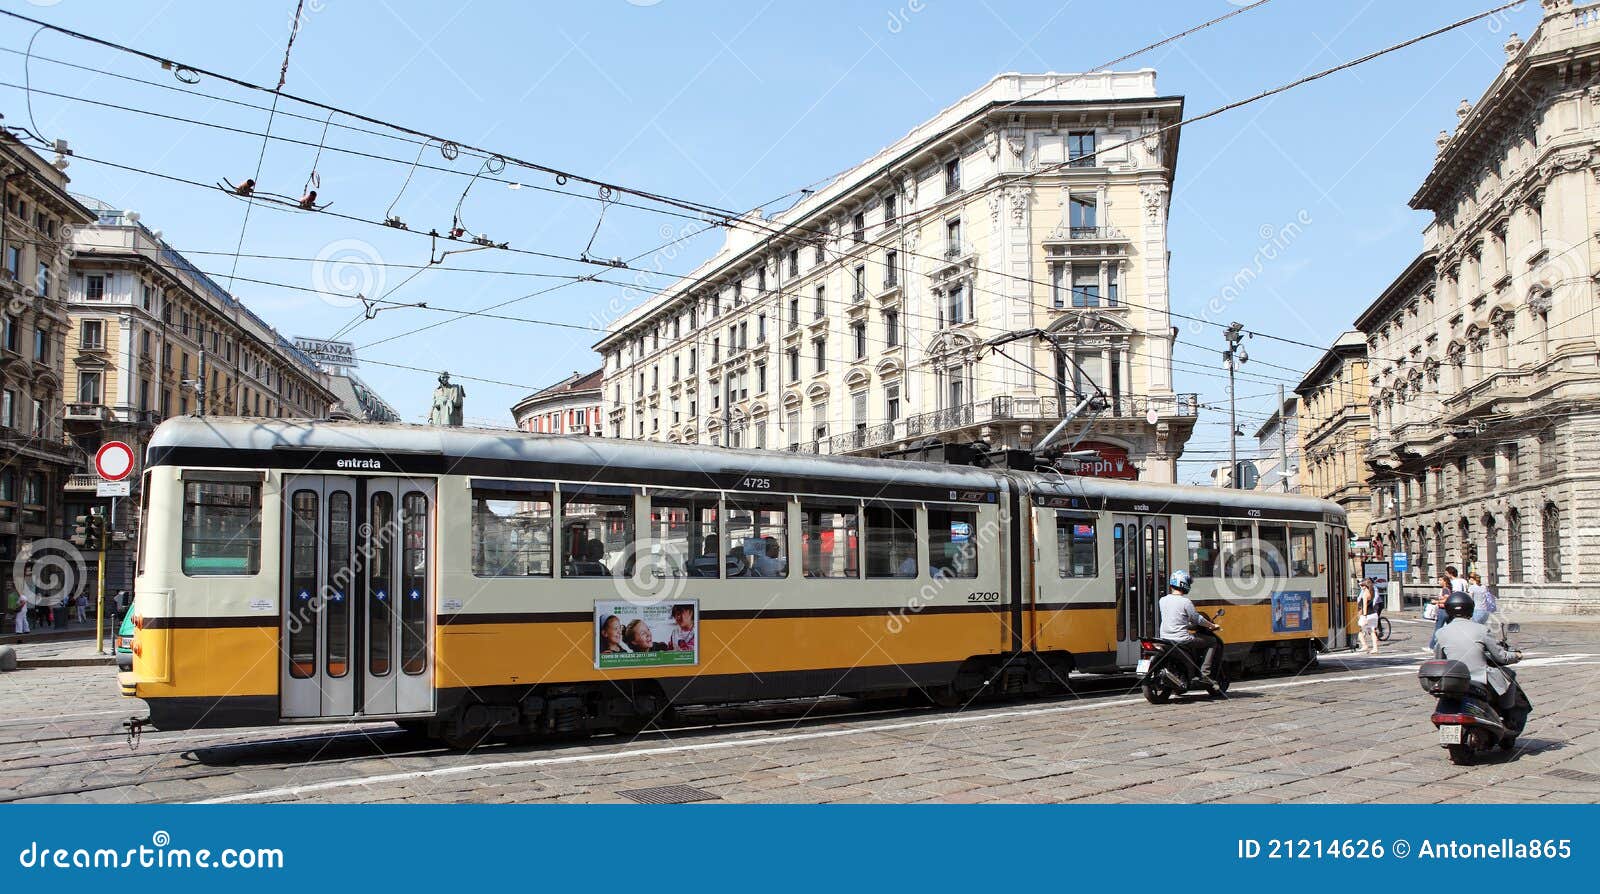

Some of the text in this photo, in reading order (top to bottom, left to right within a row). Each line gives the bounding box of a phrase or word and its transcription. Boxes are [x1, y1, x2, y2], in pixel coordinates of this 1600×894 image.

[336, 458, 381, 469] entrata
[1081, 459, 1113, 475] mph
[743, 478, 770, 489] 4725
[967, 592, 999, 601] 4700
